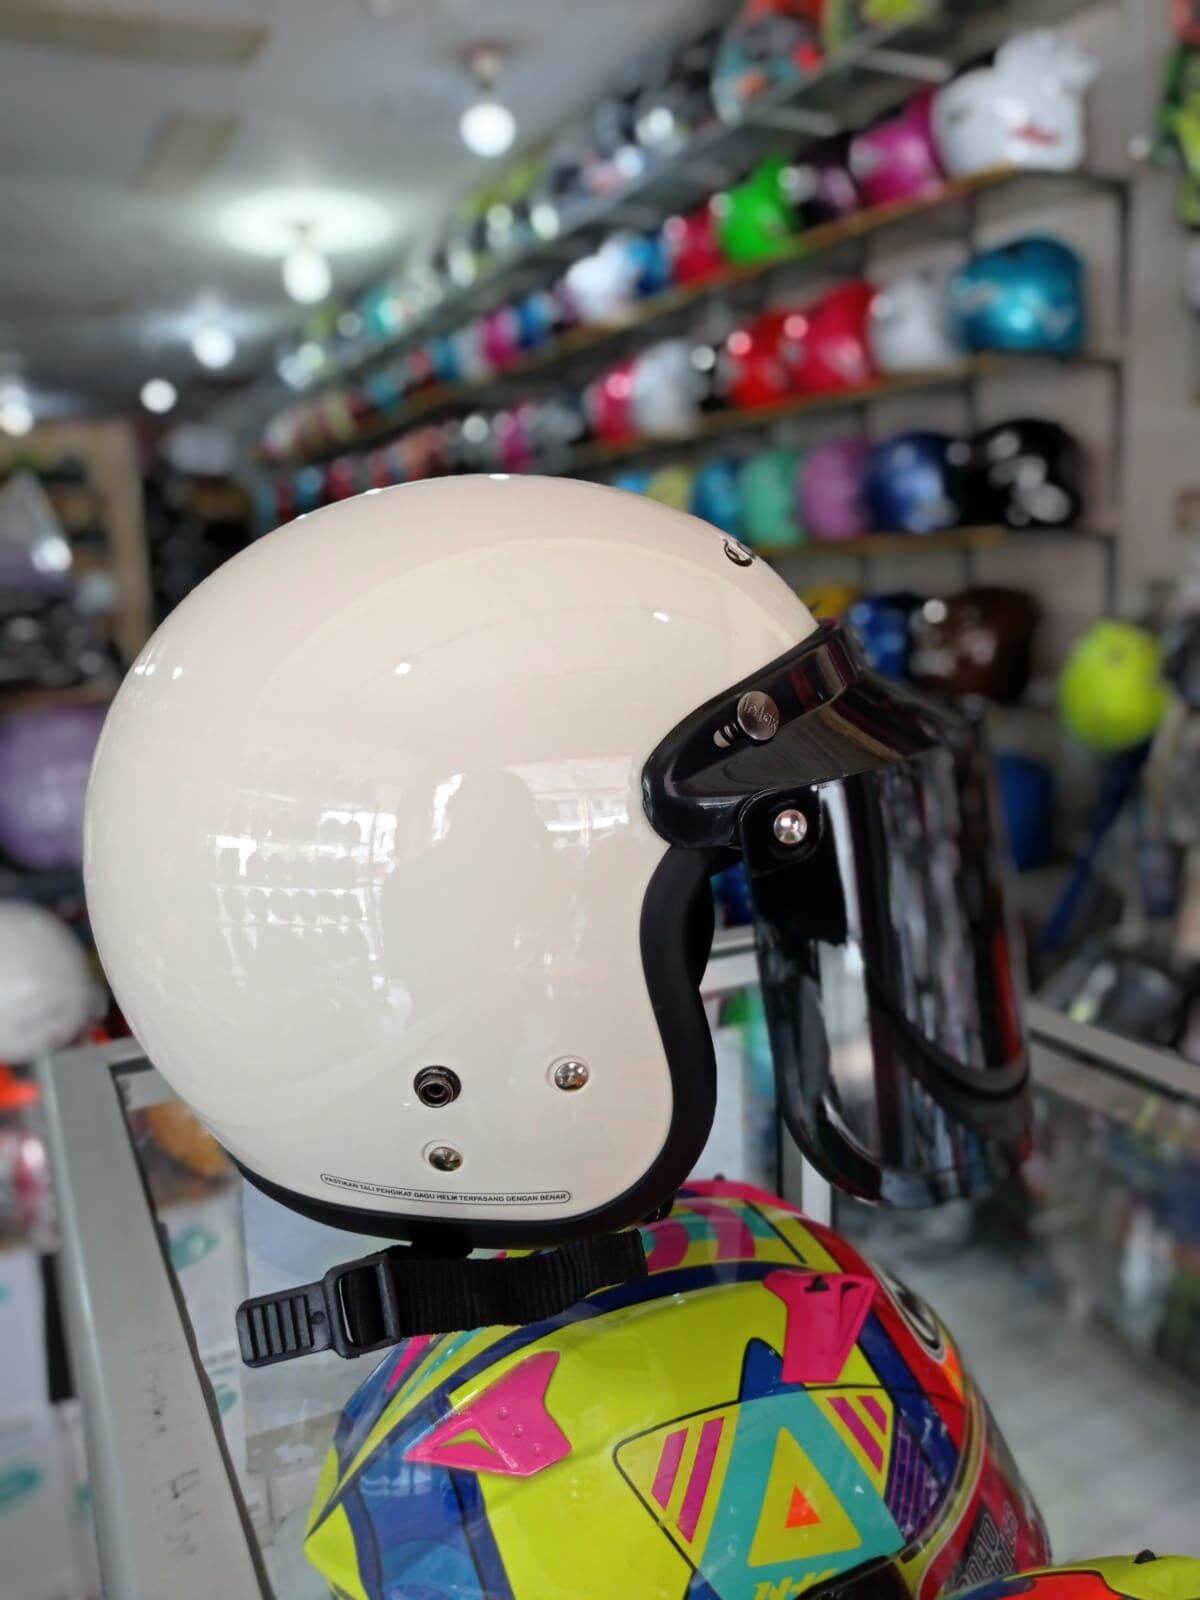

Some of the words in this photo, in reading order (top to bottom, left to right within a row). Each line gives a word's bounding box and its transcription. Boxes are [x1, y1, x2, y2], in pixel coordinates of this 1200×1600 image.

[324, 1176, 358, 1188] PASTIKAN
[360, 1184, 374, 1193] TALI
[376, 1187, 412, 1197] PENGIKAT
